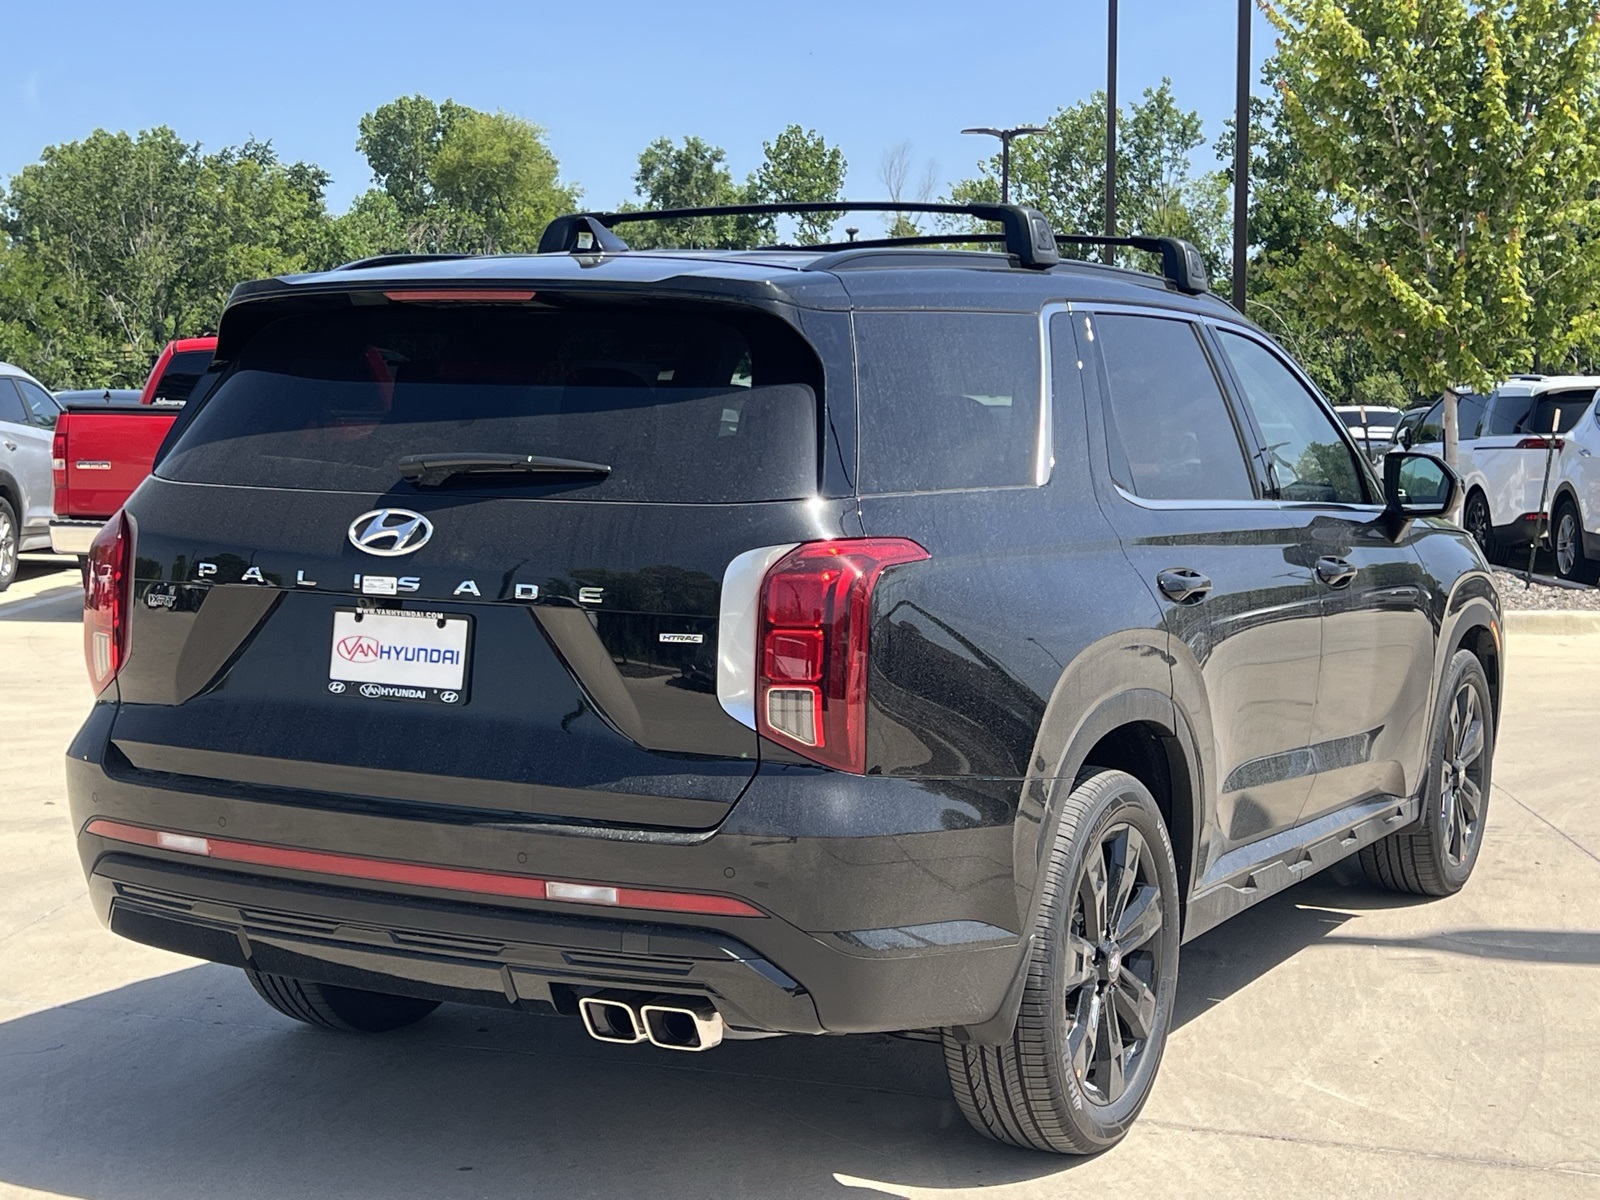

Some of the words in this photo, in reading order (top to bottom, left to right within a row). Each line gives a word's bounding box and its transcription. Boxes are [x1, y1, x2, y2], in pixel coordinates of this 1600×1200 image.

[198, 562, 604, 604] PALISADE
[147, 594, 177, 607] XRT
[356, 607, 444, 620] WWW.VANHYUNDAI.COM
[661, 634, 701, 642] HTRAC
[339, 636, 379, 662] VAN
[379, 645, 460, 665] HYUNDAI
[362, 684, 381, 698] VAN
[381, 688, 426, 699] HYUNDAI
